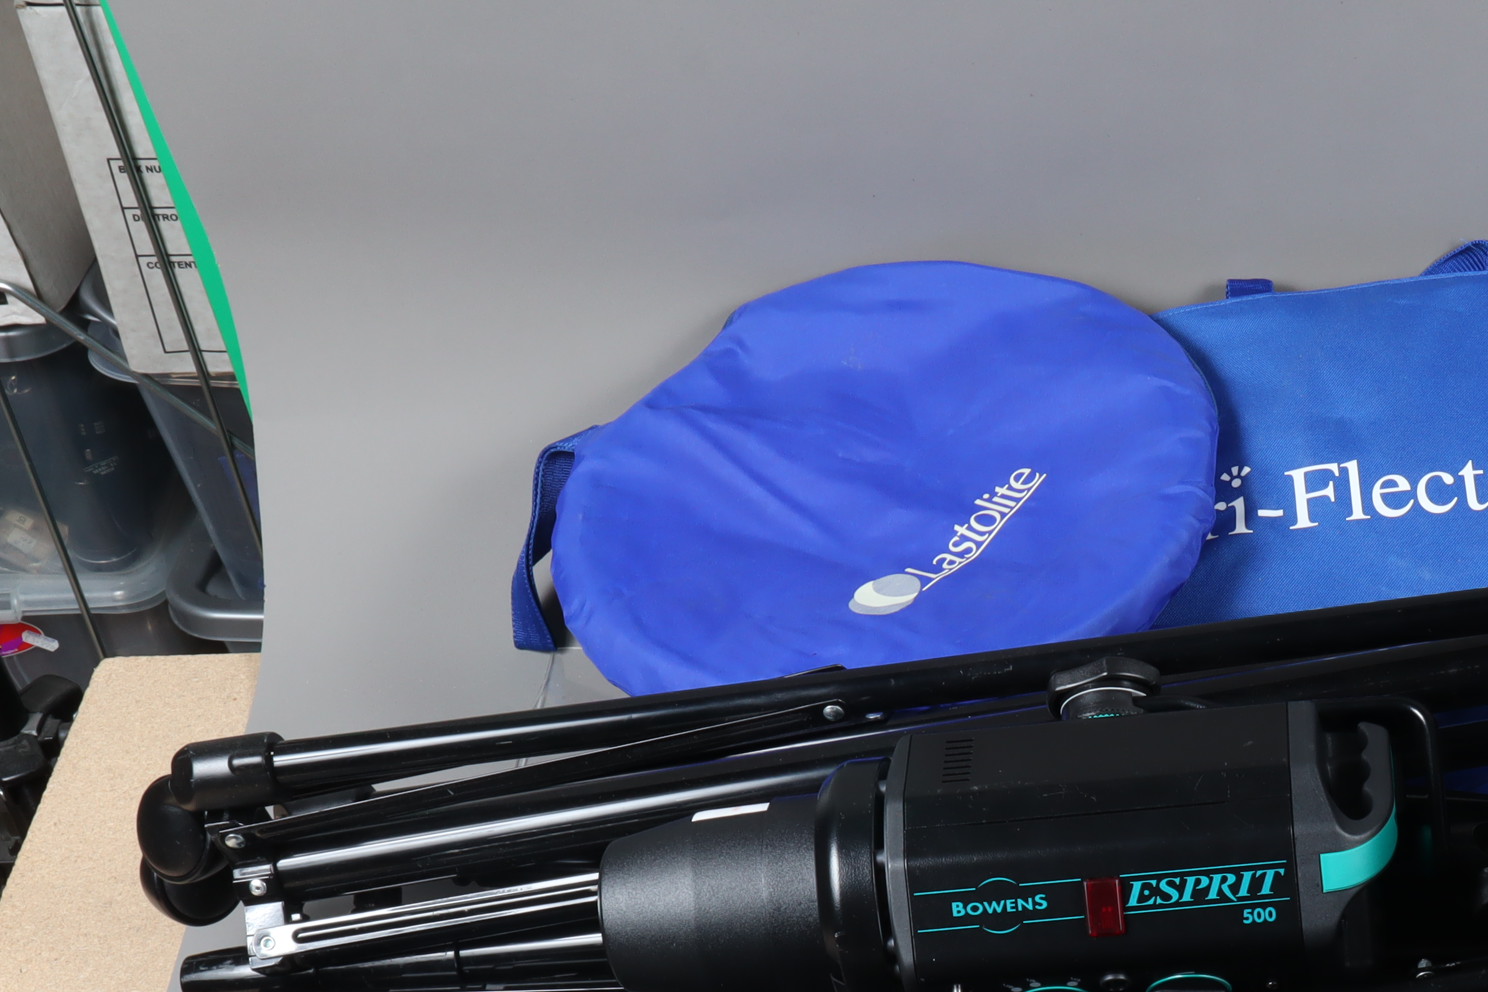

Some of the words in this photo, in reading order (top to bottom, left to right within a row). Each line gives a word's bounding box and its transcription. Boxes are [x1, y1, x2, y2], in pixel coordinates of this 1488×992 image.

[118, 165, 143, 174] BX
[905, 467, 1041, 580] Lastolite
[1125, 868, 1285, 908] ESPRIT
[951, 893, 1048, 917] BOWENS
[1242, 906, 1277, 925] 500
